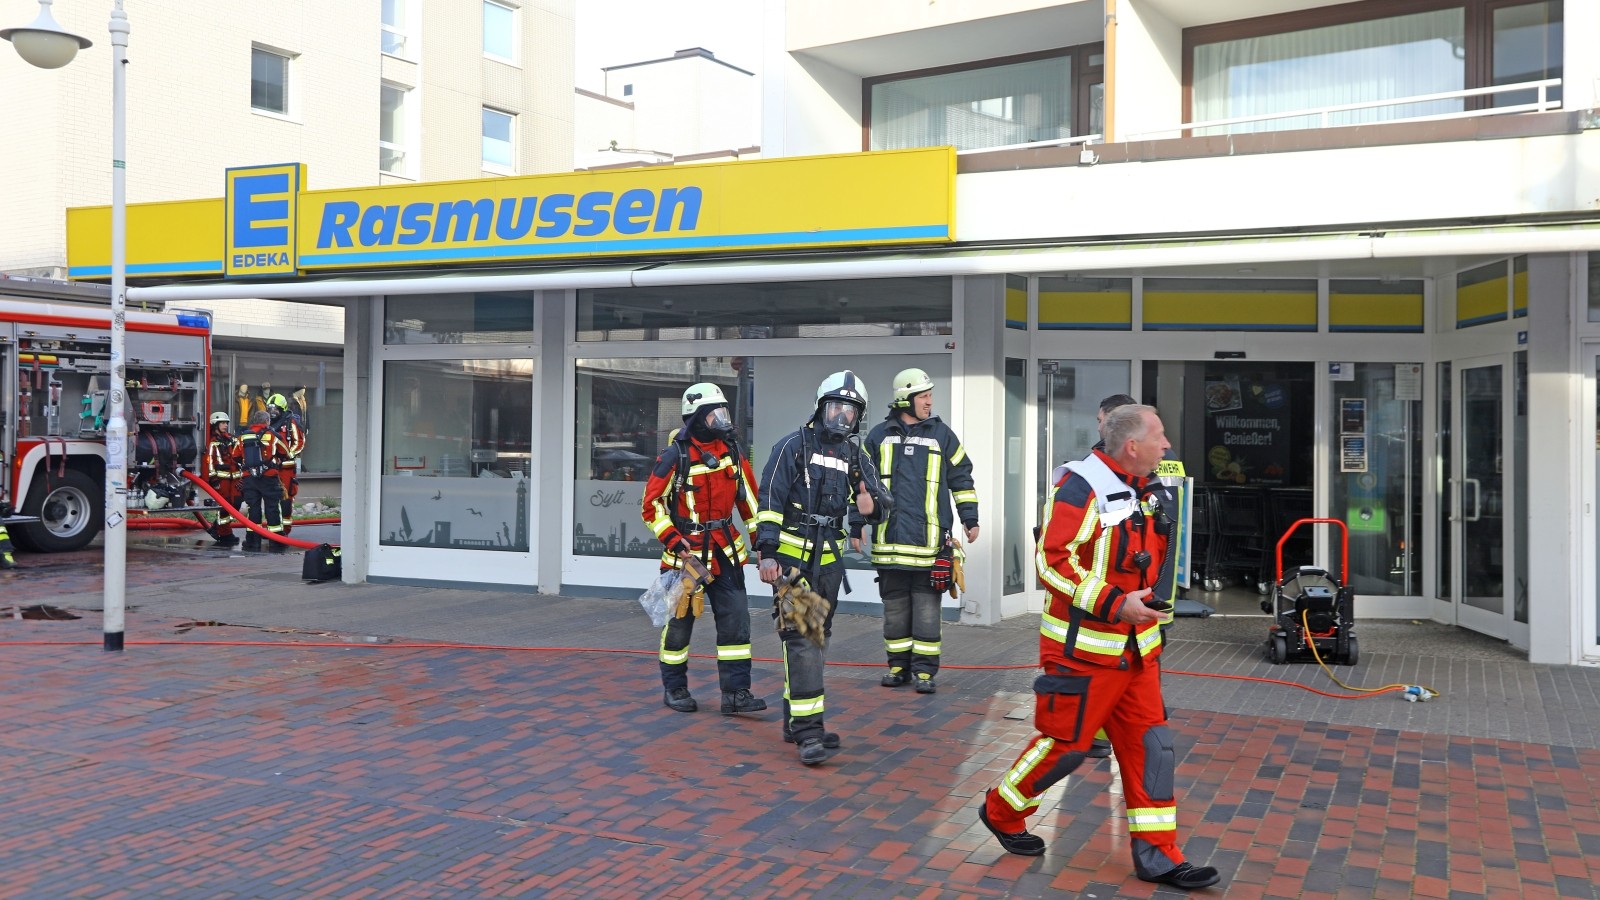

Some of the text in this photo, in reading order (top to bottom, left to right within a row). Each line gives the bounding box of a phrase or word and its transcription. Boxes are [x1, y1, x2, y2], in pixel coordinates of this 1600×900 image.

[234, 173, 288, 248] E
[316, 186, 702, 249] Rasmussen
[233, 252, 289, 268] EDEKA
[1216, 415, 1280, 430] Willkommen,
[1223, 432, 1272, 445] Genießer!
[590, 489, 625, 507] Sylt
